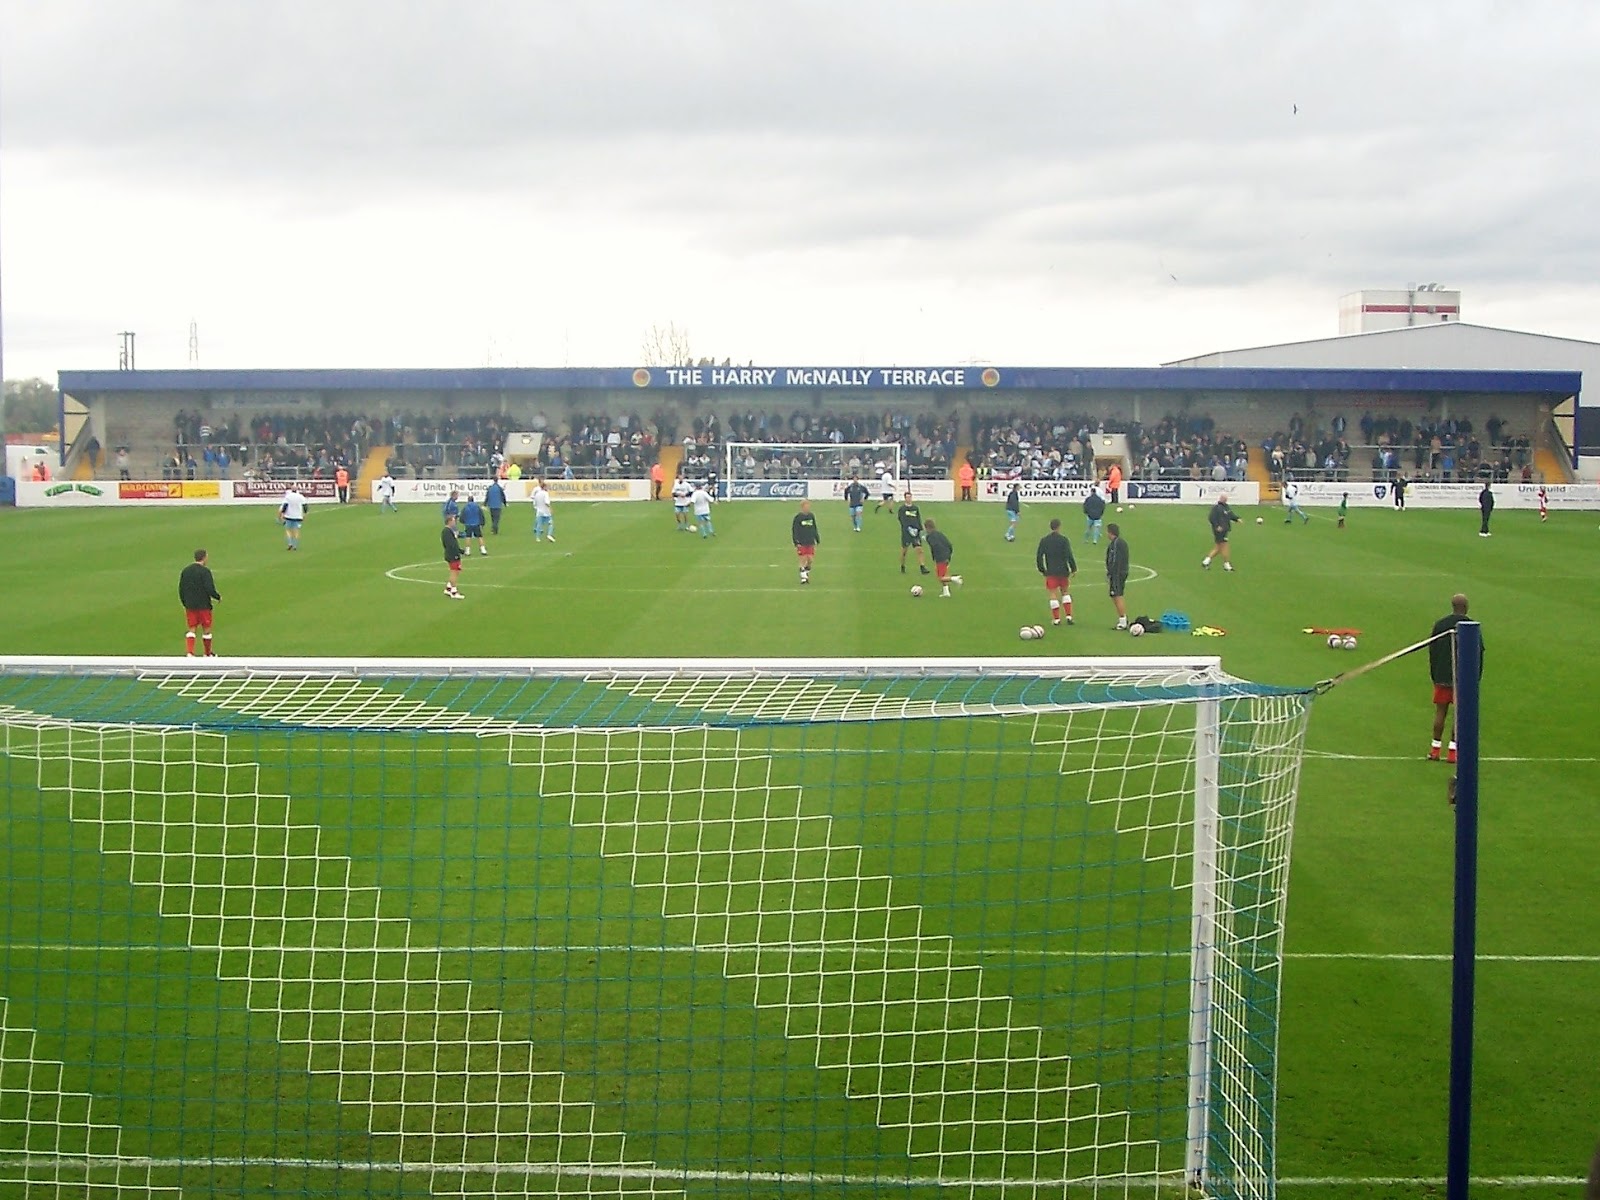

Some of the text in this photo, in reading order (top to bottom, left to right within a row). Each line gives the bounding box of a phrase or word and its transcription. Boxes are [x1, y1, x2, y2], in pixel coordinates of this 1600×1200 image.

[666, 369, 965, 385] THE HARRY McNALLY TERRACE
[423, 482, 488, 491] Unite The Unio
[546, 483, 580, 491] AGNALL
[591, 483, 626, 491] MORRIS
[726, 483, 760, 496] Coca-Cola
[770, 483, 804, 496] Coca-Cola
